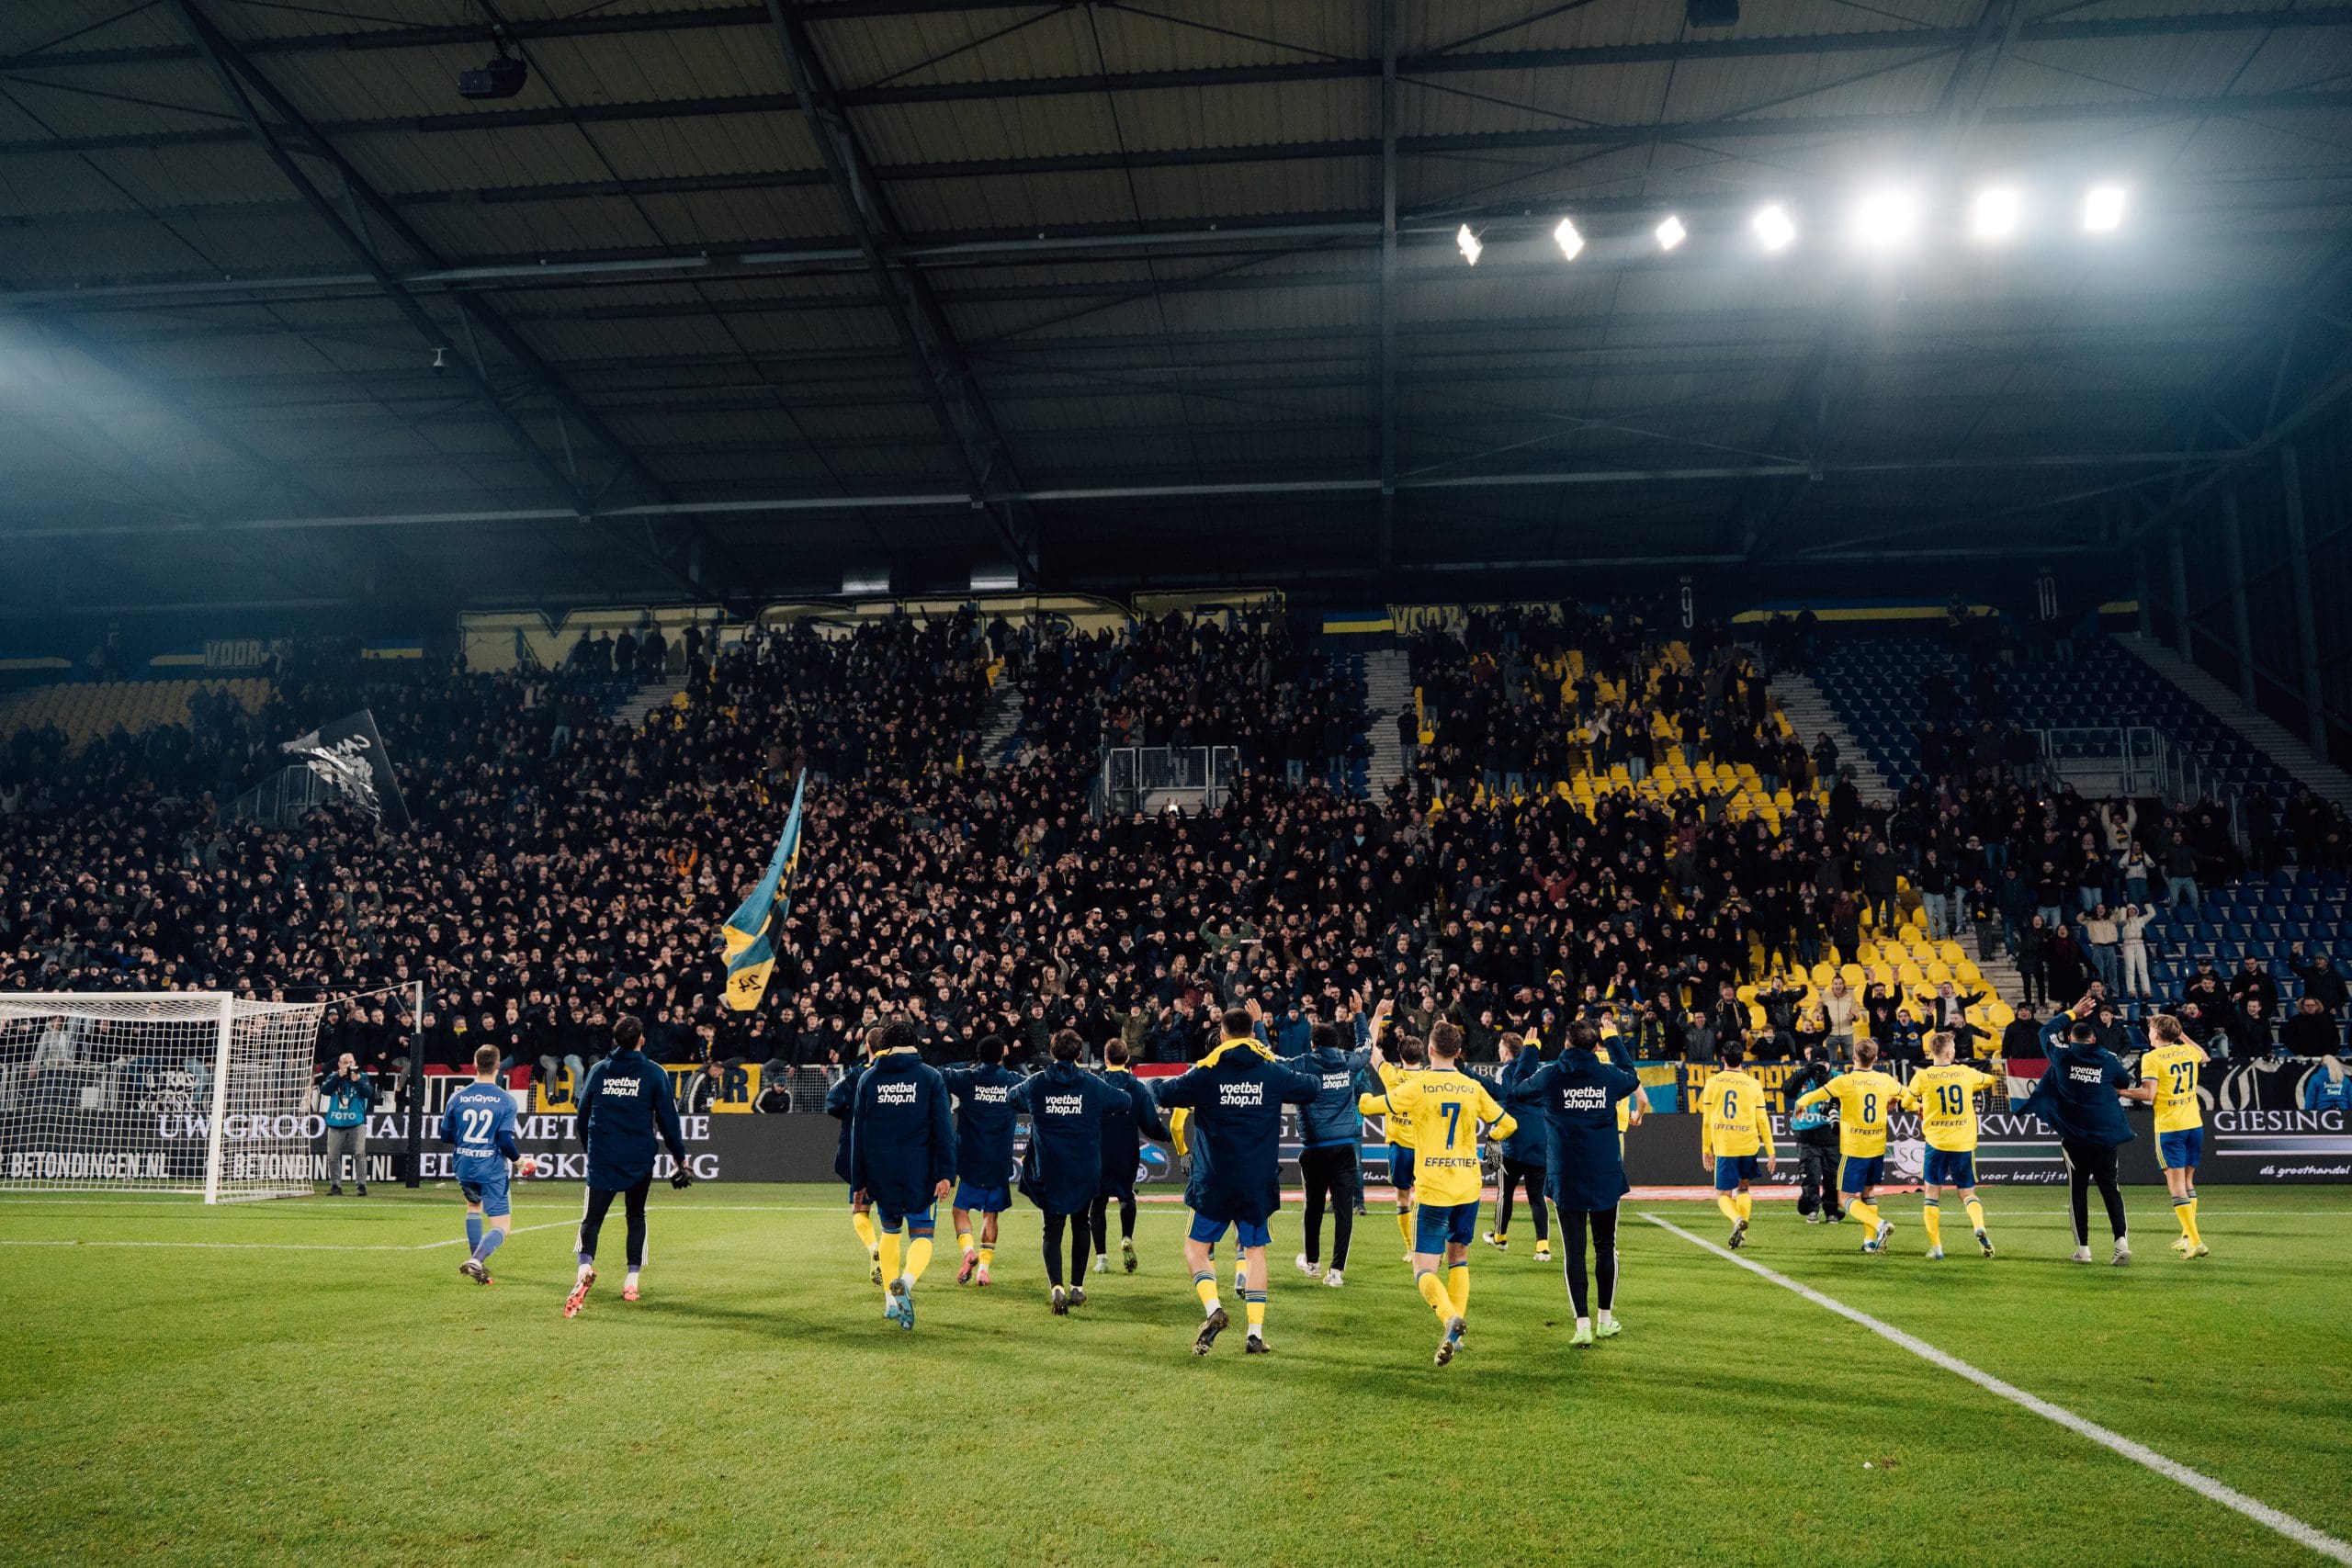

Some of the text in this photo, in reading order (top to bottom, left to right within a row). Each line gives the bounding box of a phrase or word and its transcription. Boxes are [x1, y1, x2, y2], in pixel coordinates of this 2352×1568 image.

[1681, 586, 1693, 629] 9
[205, 639, 263, 669] VOOR
[604, 1077, 640, 1089] voetbal
[1322, 1079, 1350, 1089] shop.nl
[2069, 1072, 2101, 1084] shop.nl
[2170, 1061, 2193, 1095] 27
[602, 1086, 639, 1097] shop.nl
[877, 1082, 917, 1093] voetbal
[975, 1085, 1007, 1095] voetbal
[1219, 1081, 1263, 1094] voetbal
[1564, 1087, 1606, 1098] voetbal
[877, 1092, 916, 1105] shop.nl
[974, 1092, 1007, 1103] shop.nl
[1046, 1094, 1082, 1105] voetbal
[1220, 1093, 1263, 1107] shop.nl
[1565, 1097, 1606, 1111] shop.nl
[1724, 1089, 1737, 1119] 6
[1936, 1084, 1964, 1115] 19
[1046, 1103, 1082, 1116] shop.nl
[1864, 1093, 1876, 1123] 8
[330, 1111, 356, 1120] FOTO
[2214, 1110, 2345, 1132] GIESING
[462, 1109, 493, 1144] 22
[1442, 1102, 1461, 1150] 7
[10, 1152, 169, 1179] BETONDINGEN.NL
[1424, 1157, 1476, 1168] EFFEKTIEF
